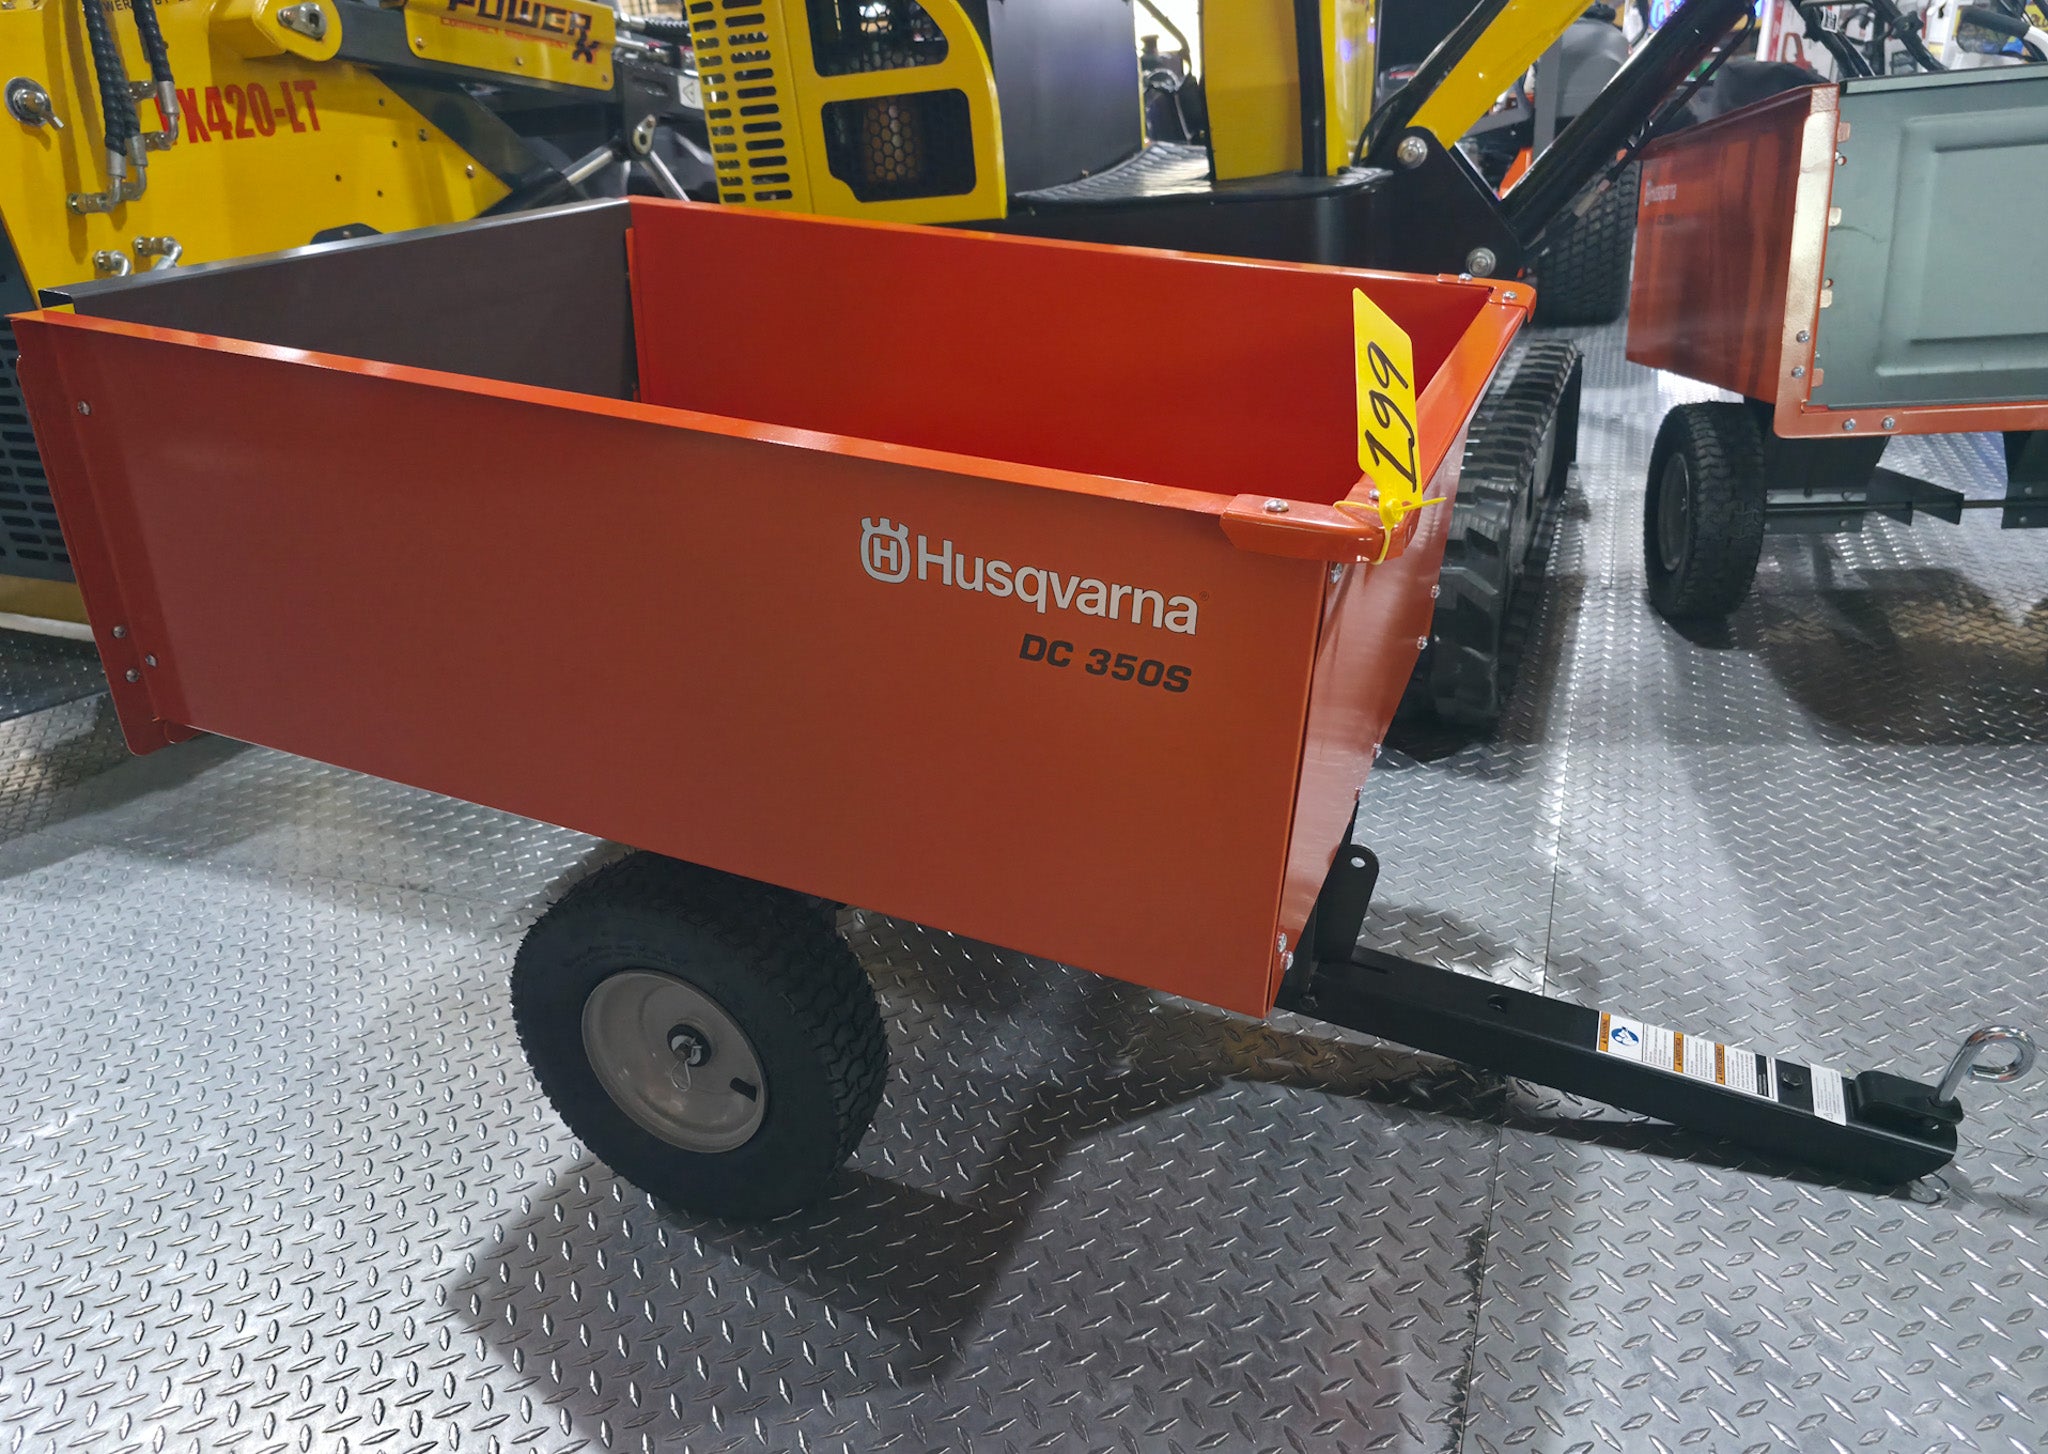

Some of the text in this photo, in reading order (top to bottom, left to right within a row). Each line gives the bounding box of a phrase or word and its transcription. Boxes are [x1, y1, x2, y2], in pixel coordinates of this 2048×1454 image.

[153, 80, 321, 146] X420-LT
[917, 534, 1198, 635] Husqvarna
[1019, 633, 1192, 693] DC 350S
